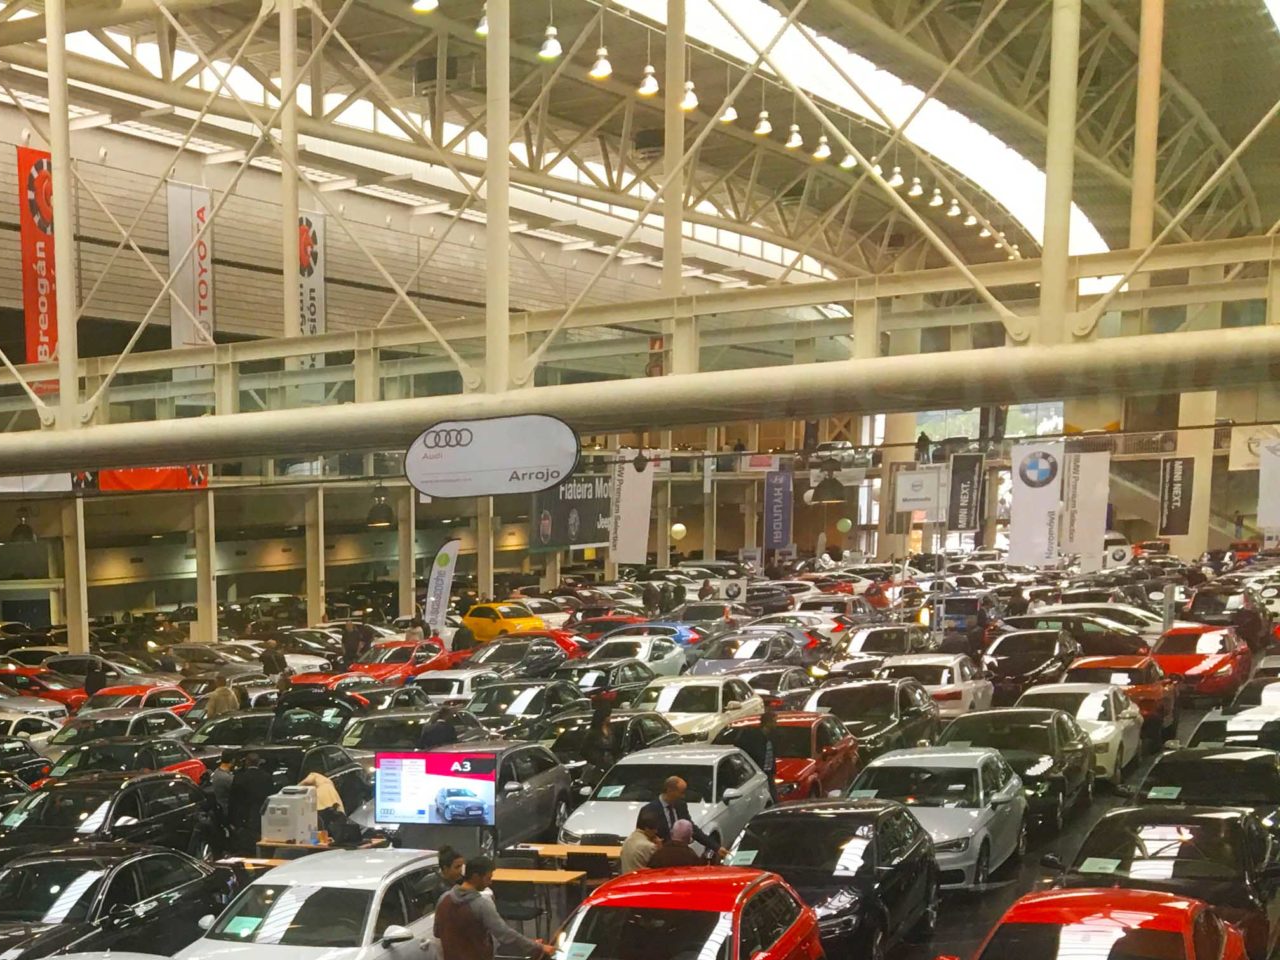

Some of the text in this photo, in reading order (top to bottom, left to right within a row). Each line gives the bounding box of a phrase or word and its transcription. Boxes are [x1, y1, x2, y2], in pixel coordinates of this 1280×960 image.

[32, 241, 51, 362] Breogán
[422, 452, 443, 460] Audi
[508, 468, 561, 483] Arrojo
[613, 480, 624, 514] Premium
[772, 487, 784, 543] HYUNDAI
[958, 508, 968, 529] MINI
[610, 515, 621, 552] Selection
[450, 761, 472, 772] A3
